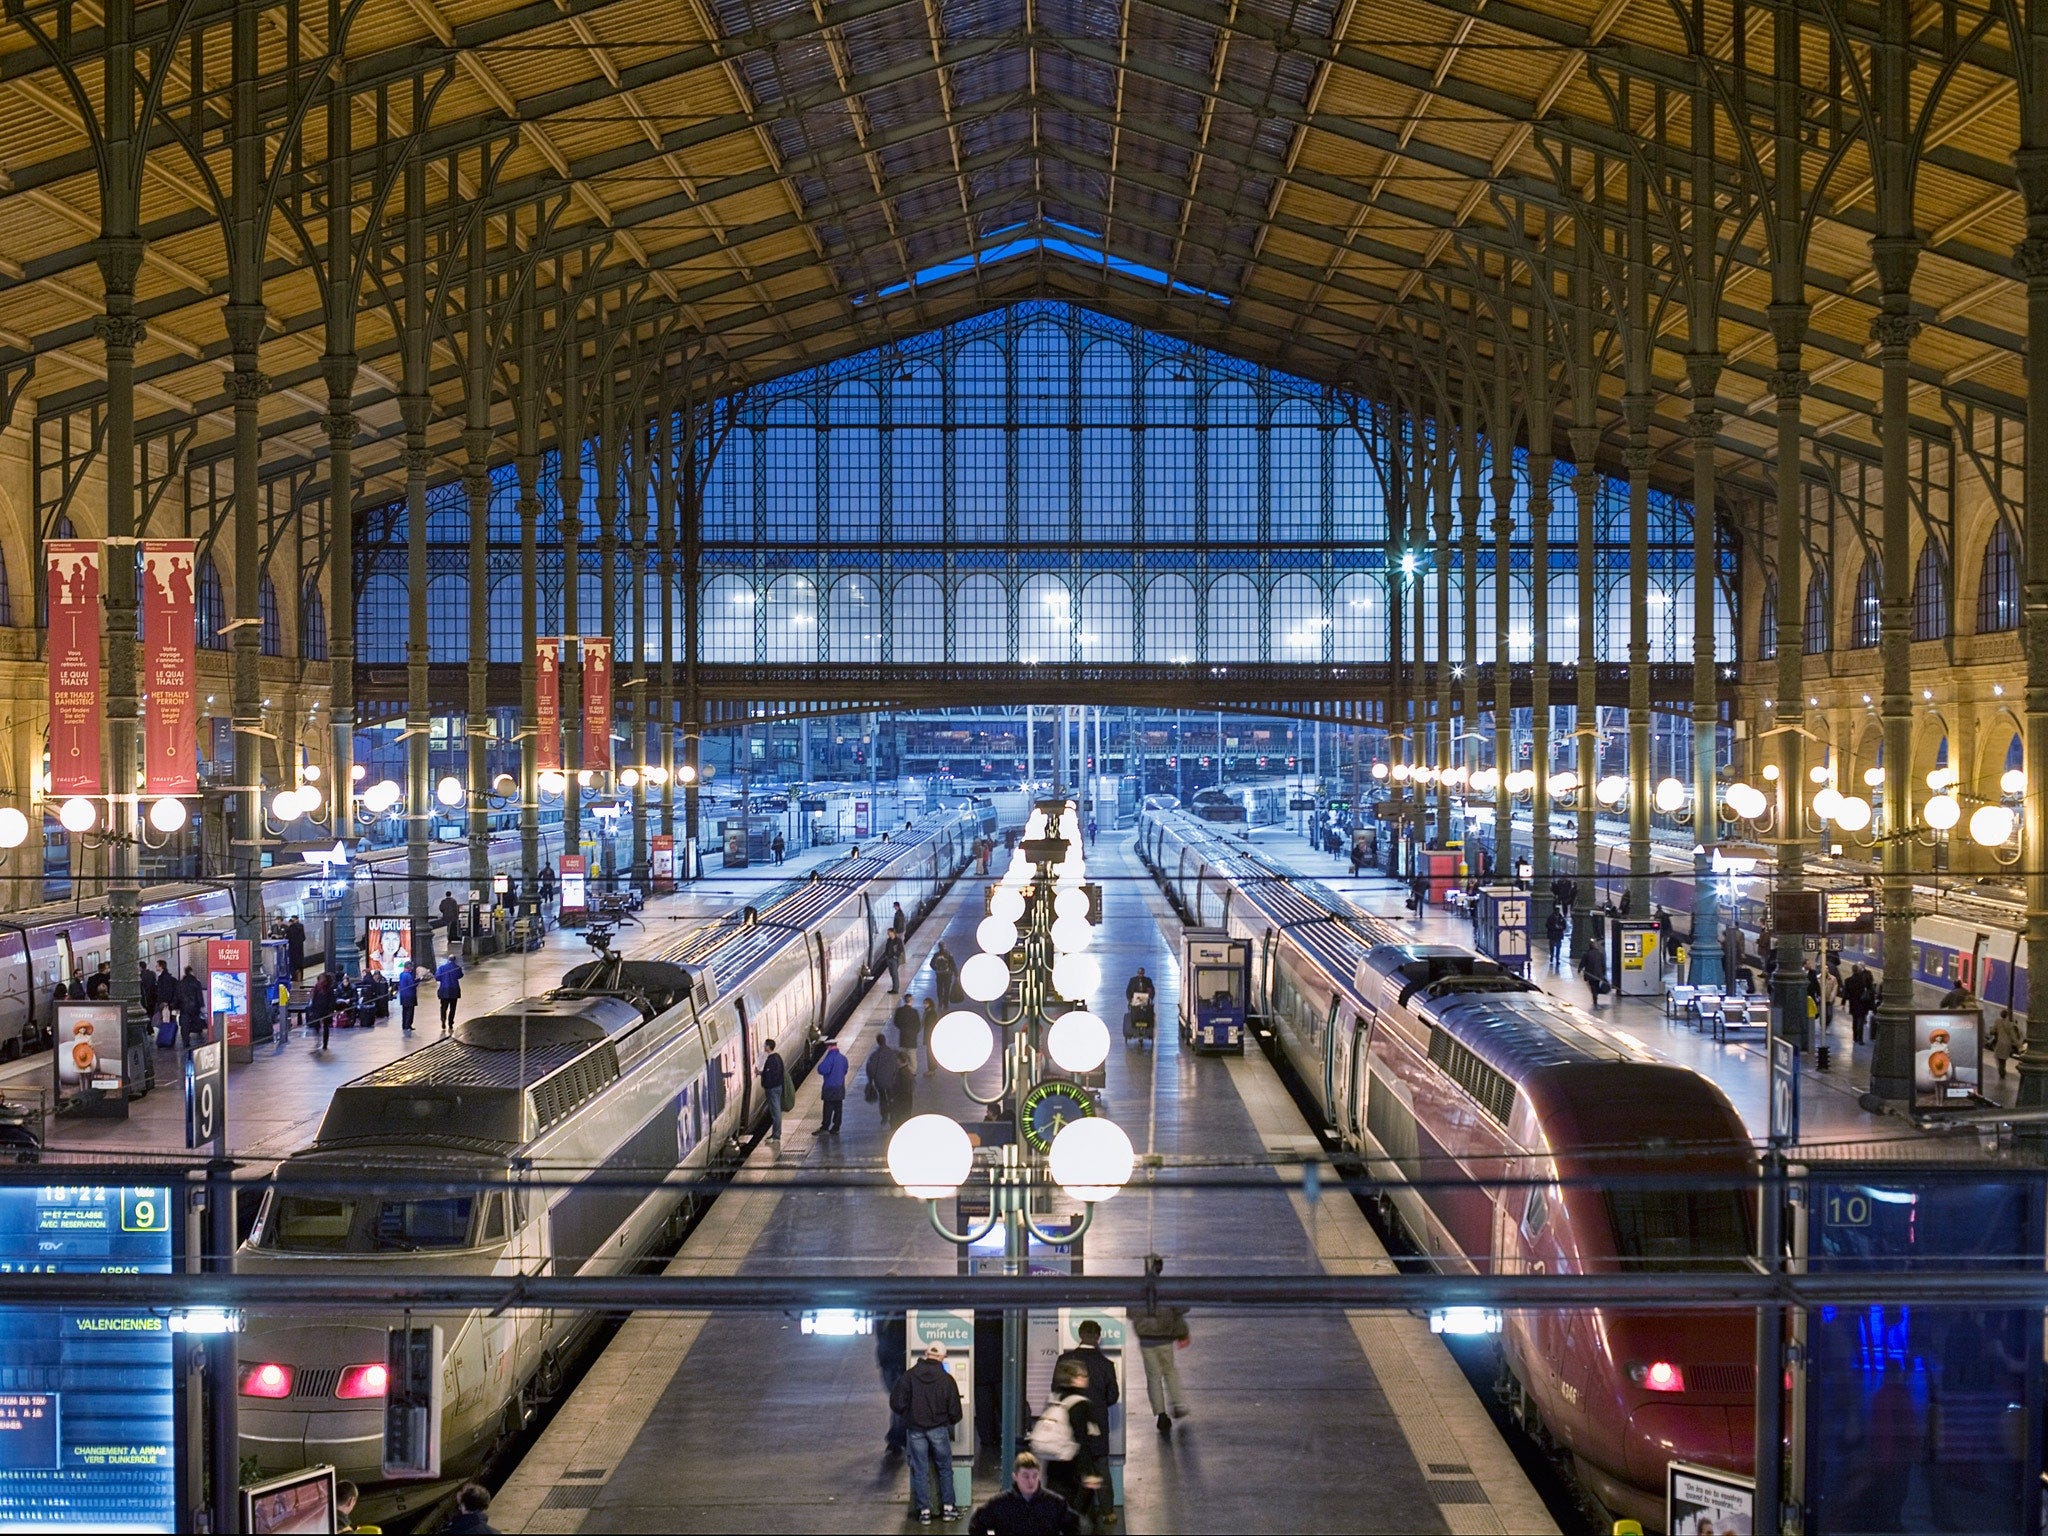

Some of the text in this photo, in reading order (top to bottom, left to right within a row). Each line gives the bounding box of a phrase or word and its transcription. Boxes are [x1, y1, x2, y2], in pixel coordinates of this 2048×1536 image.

[60, 678, 89, 686] THALYS
[70, 691, 94, 699] THALYS
[368, 918, 411, 930] OUVERTURE
[202, 1083, 213, 1138] 9
[1776, 1078, 1789, 1135] 10
[135, 1201, 155, 1228] 9
[1830, 1197, 1868, 1223] 10
[76, 1211, 103, 1219] CLASSE
[40, 1220, 106, 1228] AVEC RESERVATION
[38, 1242, 63, 1250] TGV
[76, 1318, 162, 1331] VALENCIENNES
[920, 1320, 948, 1330] échange
[926, 1329, 968, 1339] minute
[1101, 1329, 1121, 1338] ute
[74, 1446, 167, 1455] CHANGEMENT A ARRAS
[84, 1456, 157, 1464] VERS DUNKERQUE
[0, 1471, 47, 1479] POSITION
